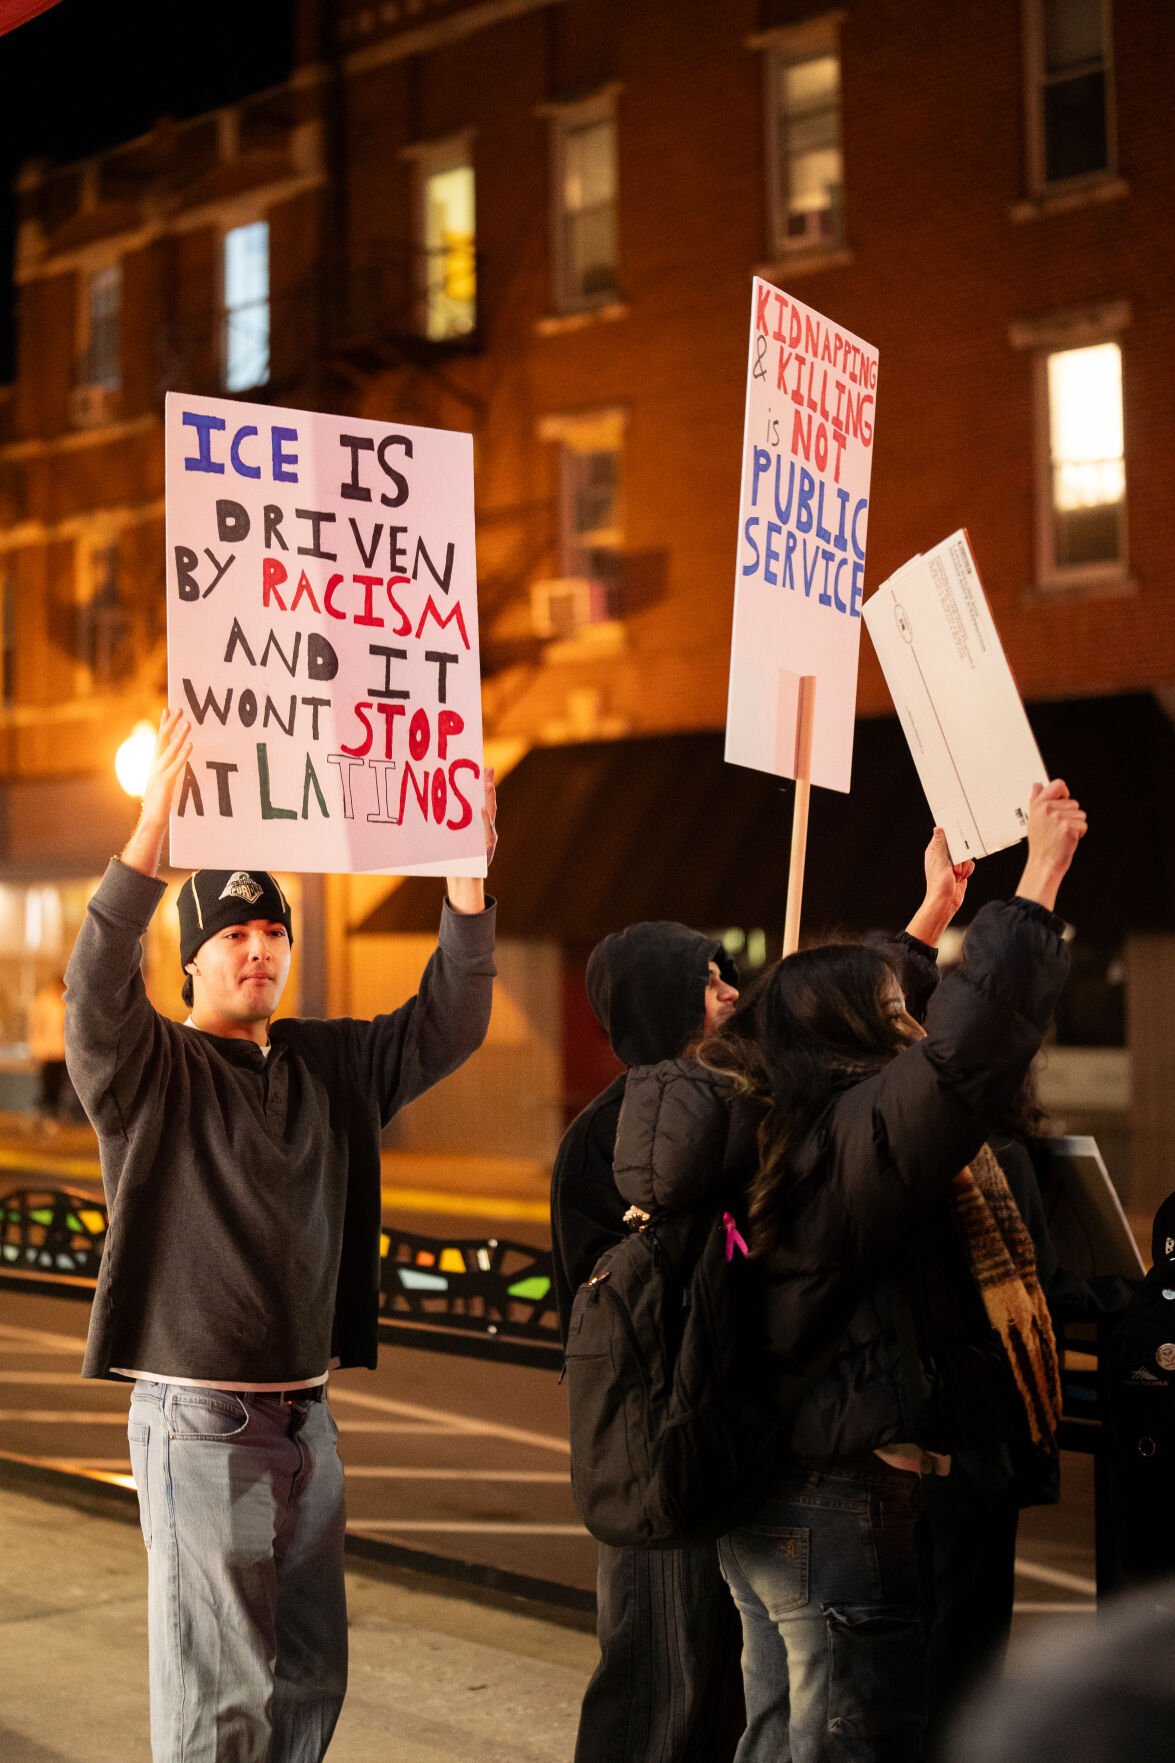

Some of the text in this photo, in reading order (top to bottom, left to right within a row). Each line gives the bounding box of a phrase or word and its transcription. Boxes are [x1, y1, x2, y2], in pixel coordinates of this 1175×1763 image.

[756, 285, 877, 389] KIDNAPPING
[752, 334, 874, 447] & KILLING
[182, 411, 413, 508] ICE IS
[767, 408, 847, 484] is NOT
[215, 499, 455, 595] DRIVEN
[751, 445, 868, 561] PUBLIC
[174, 545, 471, 650] BY RACISM
[742, 517, 865, 618] SERVICE
[224, 617, 459, 703] AND IT
[182, 678, 465, 760] WONT STOP
[177, 743, 480, 831] AT LATINOS
